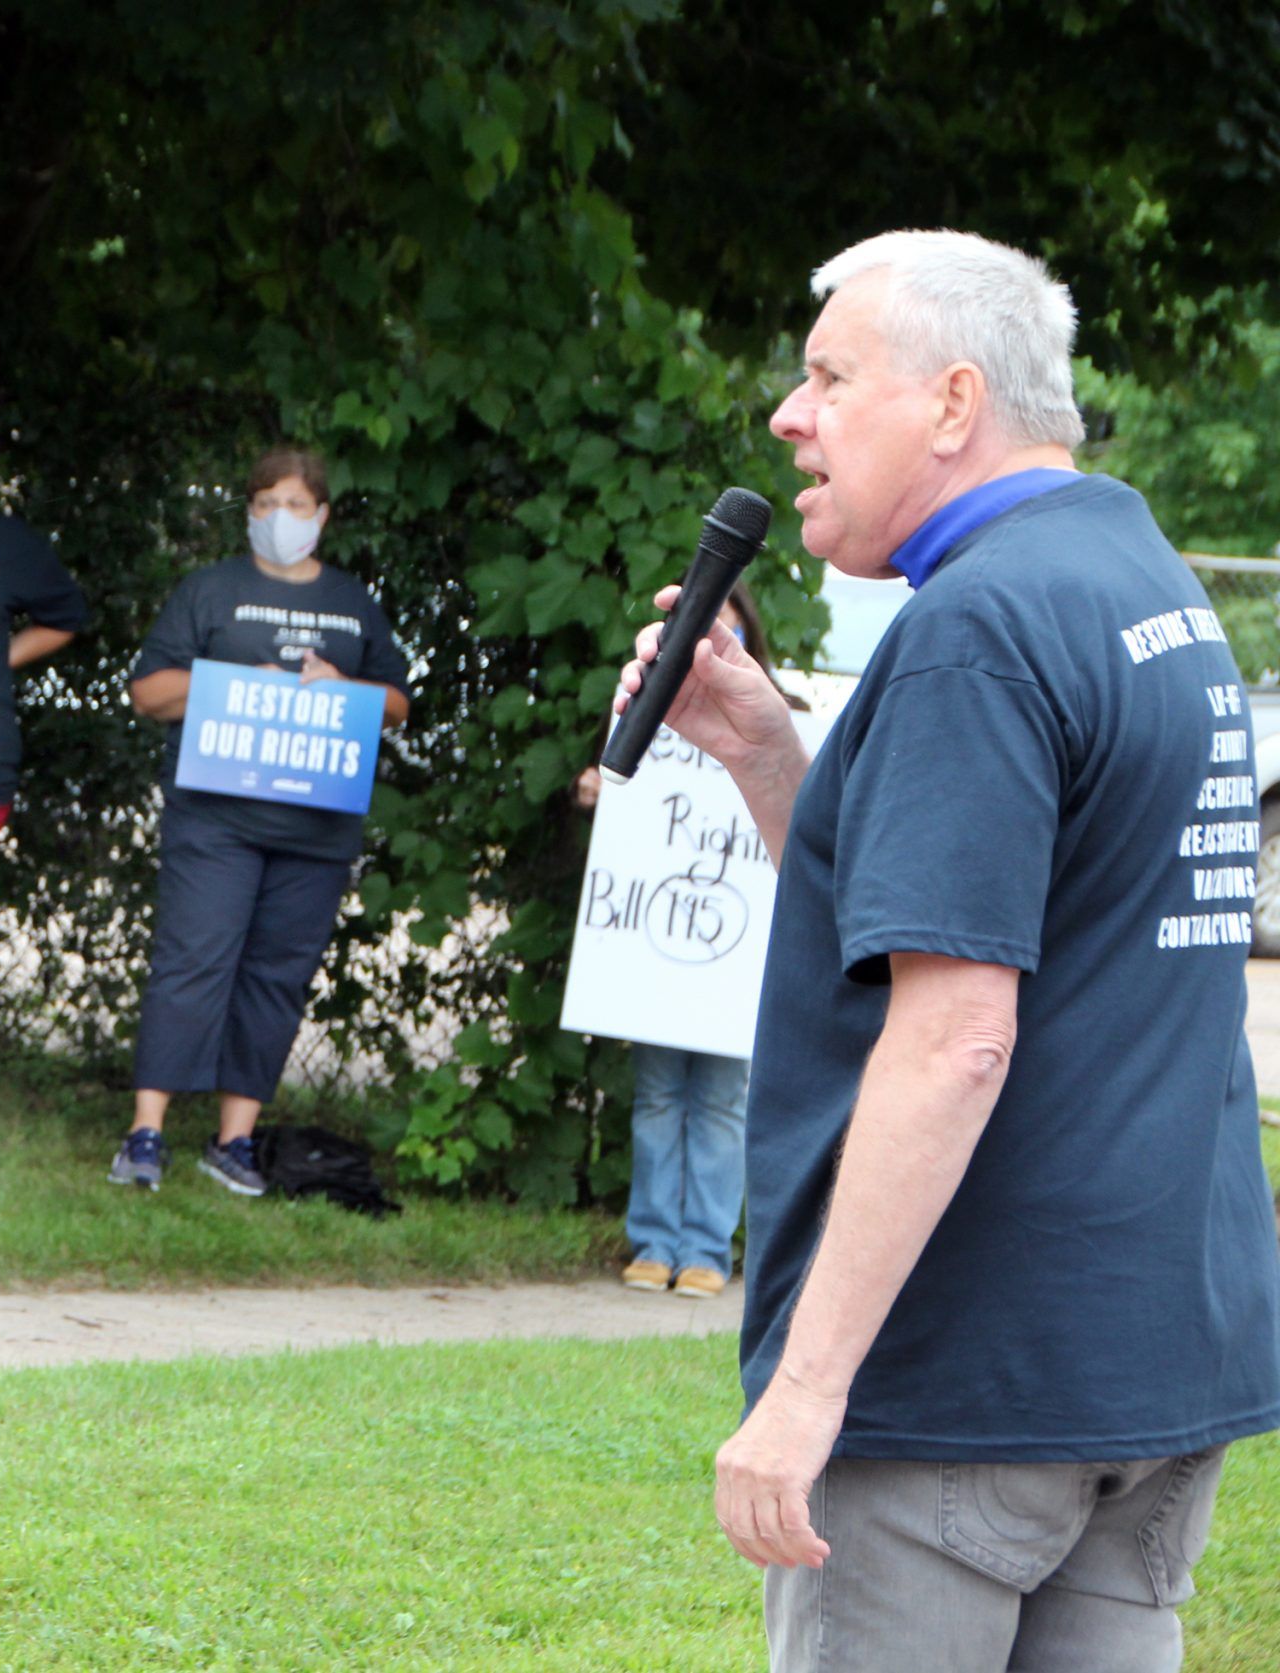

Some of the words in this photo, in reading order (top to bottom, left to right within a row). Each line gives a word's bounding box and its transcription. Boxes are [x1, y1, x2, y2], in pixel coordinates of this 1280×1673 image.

[1120, 609, 1194, 665] RESTORE
[226, 679, 347, 732] RESTORE
[198, 719, 255, 762] OUR
[259, 728, 362, 779] RIGHTS
[586, 868, 644, 930] Bill
